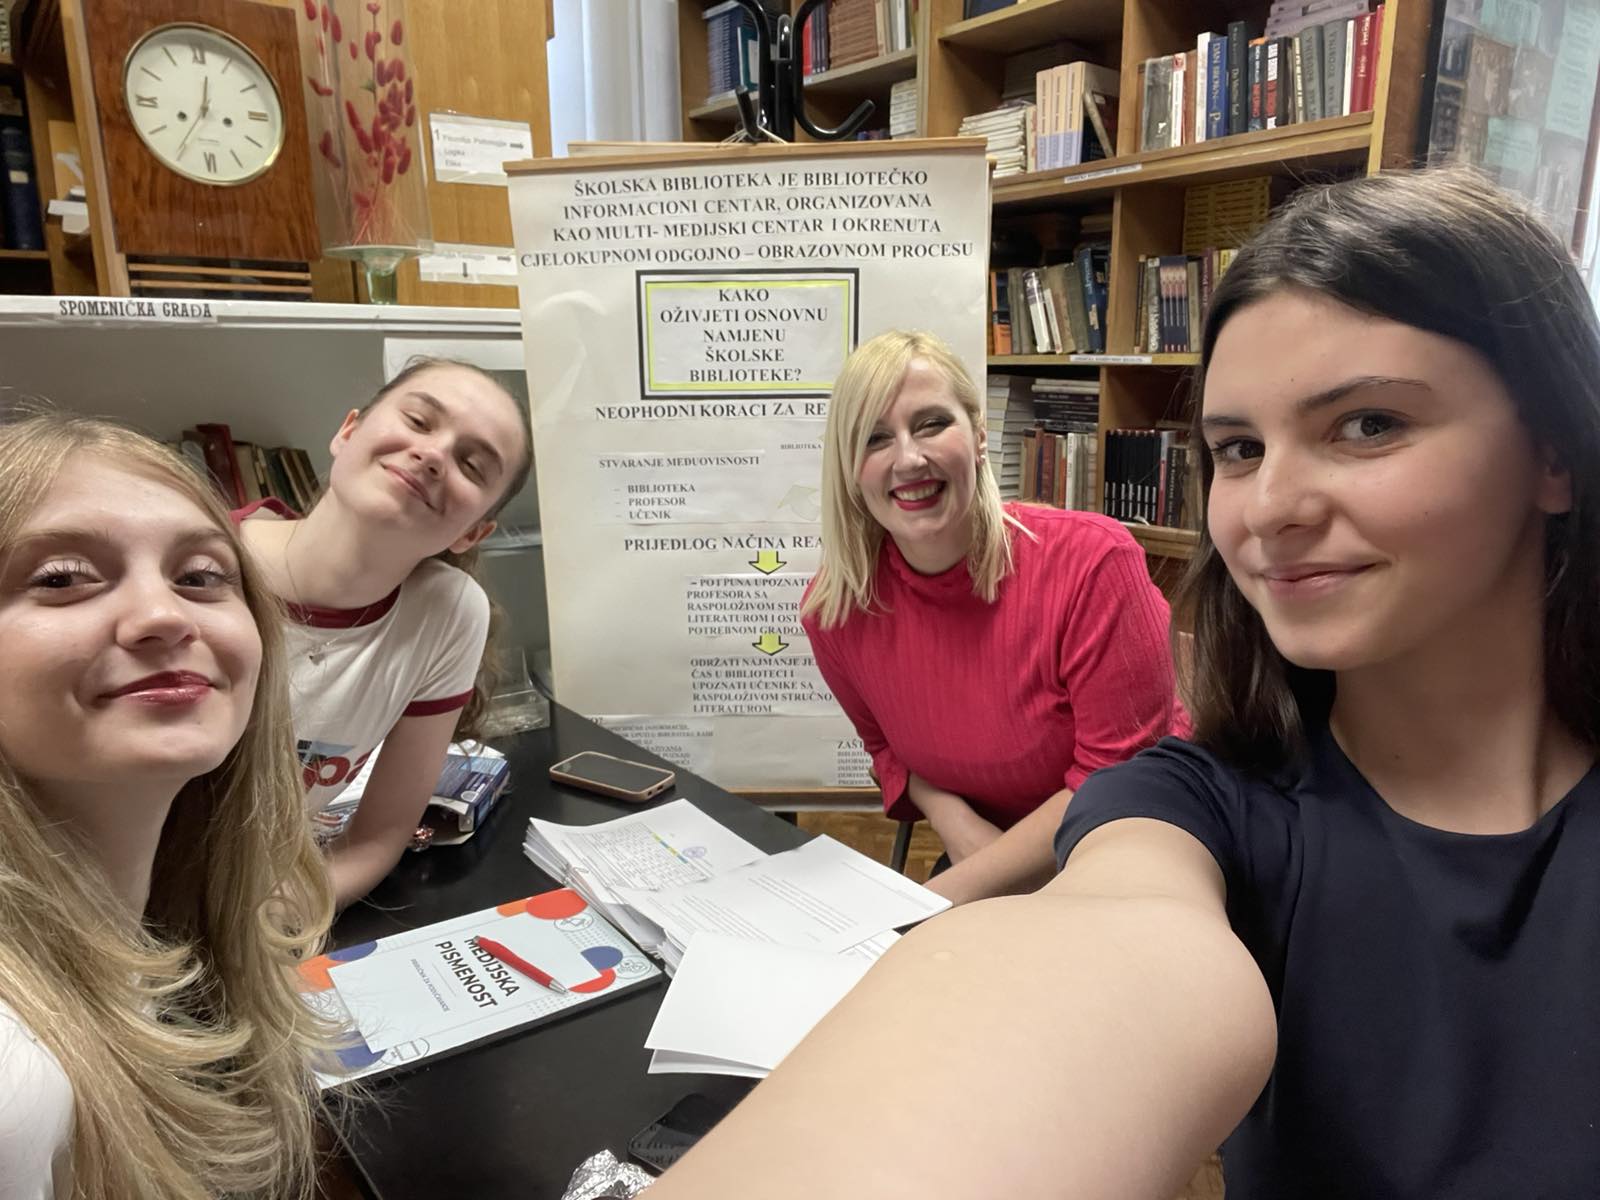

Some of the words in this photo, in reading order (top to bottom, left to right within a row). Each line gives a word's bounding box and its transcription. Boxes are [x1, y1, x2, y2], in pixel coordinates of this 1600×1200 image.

[574, 178, 657, 198] ŠKOLSKA
[662, 171, 772, 192] BIBLIOTEKA
[778, 173, 798, 188] JE
[804, 168, 928, 187] BIBLIOTEČKO
[564, 200, 697, 220] INFORMACIONI
[703, 197, 781, 214] CENTAR,
[786, 193, 932, 212] ORGANIZOVANA
[553, 227, 591, 242] KAO
[596, 224, 659, 241] MULTI-
[664, 221, 747, 239] MEDIJSKI
[752, 219, 824, 234] CENTAR
[832, 218, 837, 232] I
[843, 218, 942, 233] OKRENUTA
[520, 248, 651, 269] CJELOKUPNOM
[655, 246, 741, 263] ODGOJNO
[758, 243, 886, 259] OBRAZOVNOM
[892, 243, 974, 258] PROCESU
[718, 288, 770, 302] KAKO
[59, 300, 156, 317] SPOMENIČKA
[162, 302, 212, 318] GRAĐA
[660, 306, 739, 323] OŽIVJETI
[744, 307, 828, 322] OSNOVNU
[703, 329, 786, 343] NAMJENU
[705, 345, 785, 362] ŠKOLSKE
[690, 368, 802, 383] BIBLIOTEKE?
[595, 404, 696, 420] NEOPHODNI
[700, 403, 767, 418] KORACI
[773, 402, 795, 416] ZA
[599, 458, 664, 469] STVARANJE
[628, 483, 695, 494] BIBLIOTEKA
[628, 496, 687, 507] PROFESOR
[629, 508, 671, 520] UČENIK
[624, 536, 717, 552] PRIJEDLOG
[722, 533, 786, 549] NAČINA
[700, 578, 752, 588] POTPUNA
[687, 590, 752, 600] PROFESORA
[754, 590, 768, 600] SA
[687, 600, 775, 611] RASPOLOŽIVOM
[688, 614, 768, 624] LITERATUROM
[688, 626, 756, 636] POTREBNOM
[690, 656, 740, 667] ODRŽATI
[741, 657, 801, 667] NAJMANJE
[691, 668, 712, 679] ČAS
[715, 670, 722, 678] U
[725, 669, 786, 678] BIBLIOTECI
[692, 681, 746, 691] UPOZNATI
[749, 679, 798, 690] UČENIKE
[800, 681, 814, 690] SA
[692, 690, 778, 702] RASPOLOŽIVOM
[693, 704, 772, 713] LITERATUROM
[464, 937, 520, 997] MEDIJSKA
[435, 940, 498, 1008] PISMENOST
